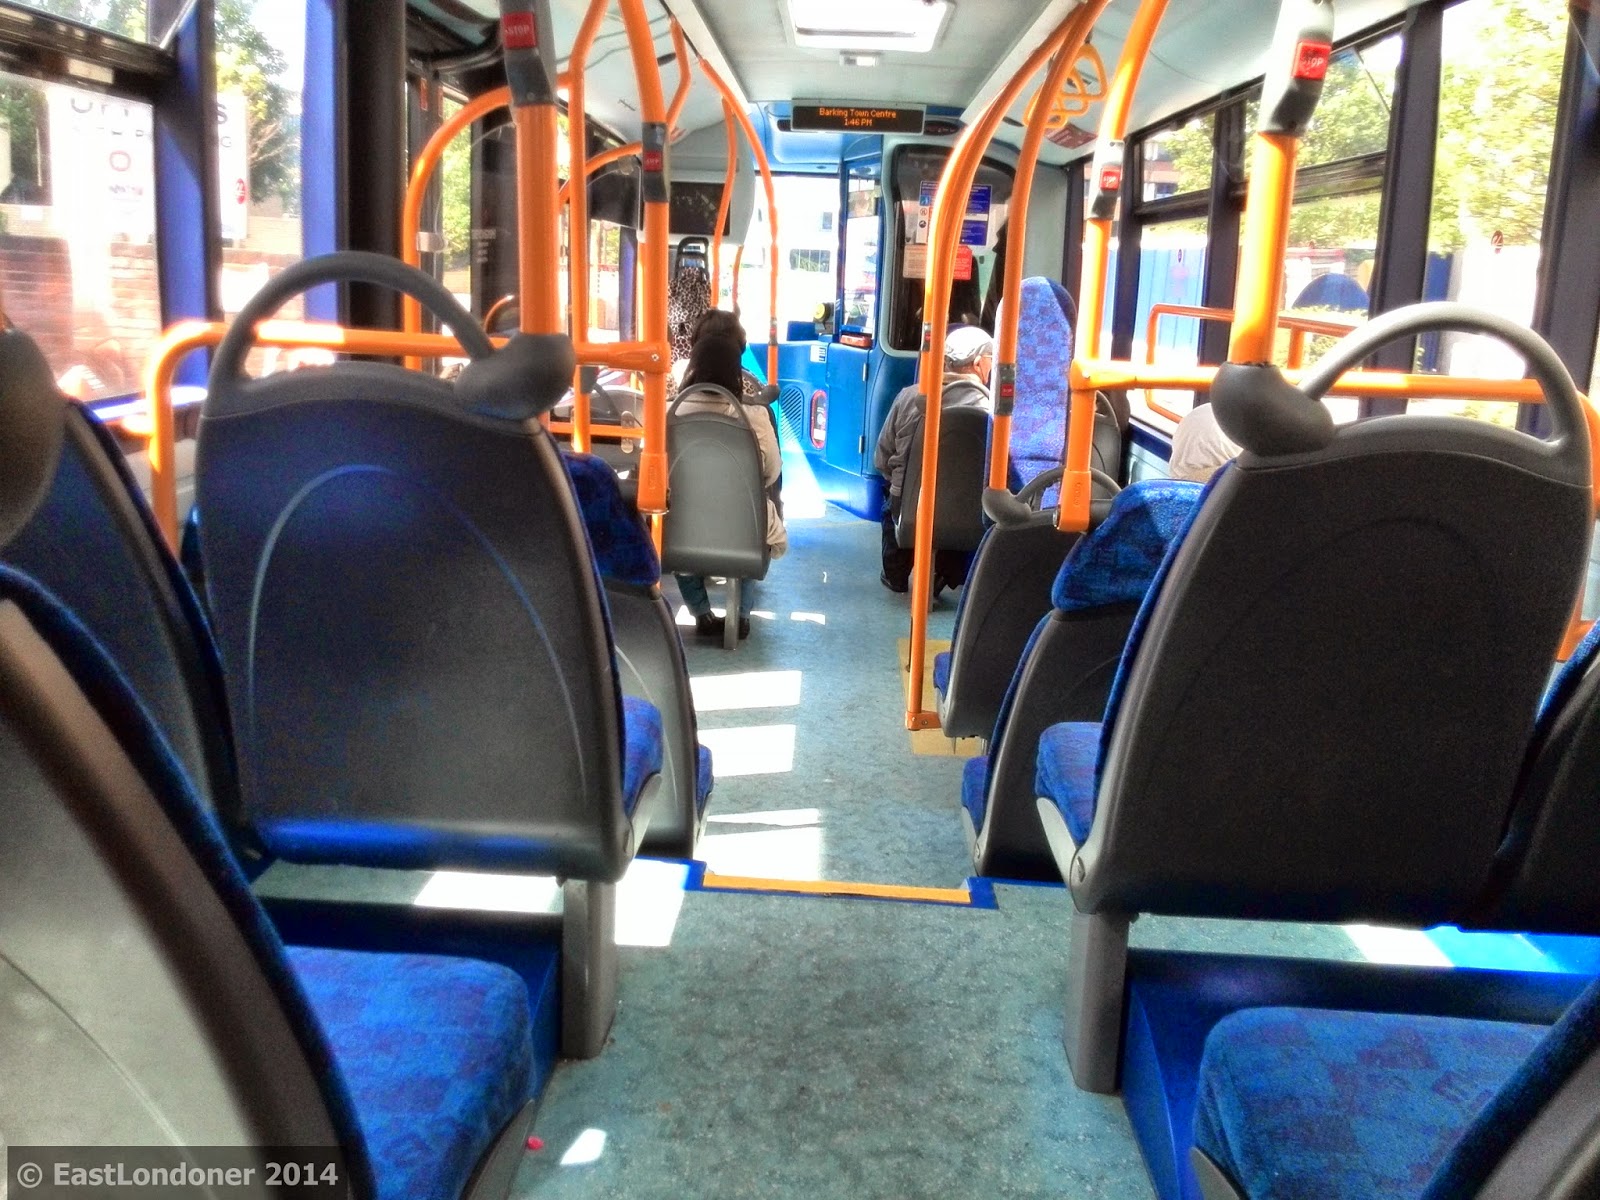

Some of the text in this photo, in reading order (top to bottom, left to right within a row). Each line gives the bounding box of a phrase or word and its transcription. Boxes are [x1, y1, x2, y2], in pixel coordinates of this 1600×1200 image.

[819, 107, 897, 118] Barking Town Centre
[861, 118, 873, 126] PM
